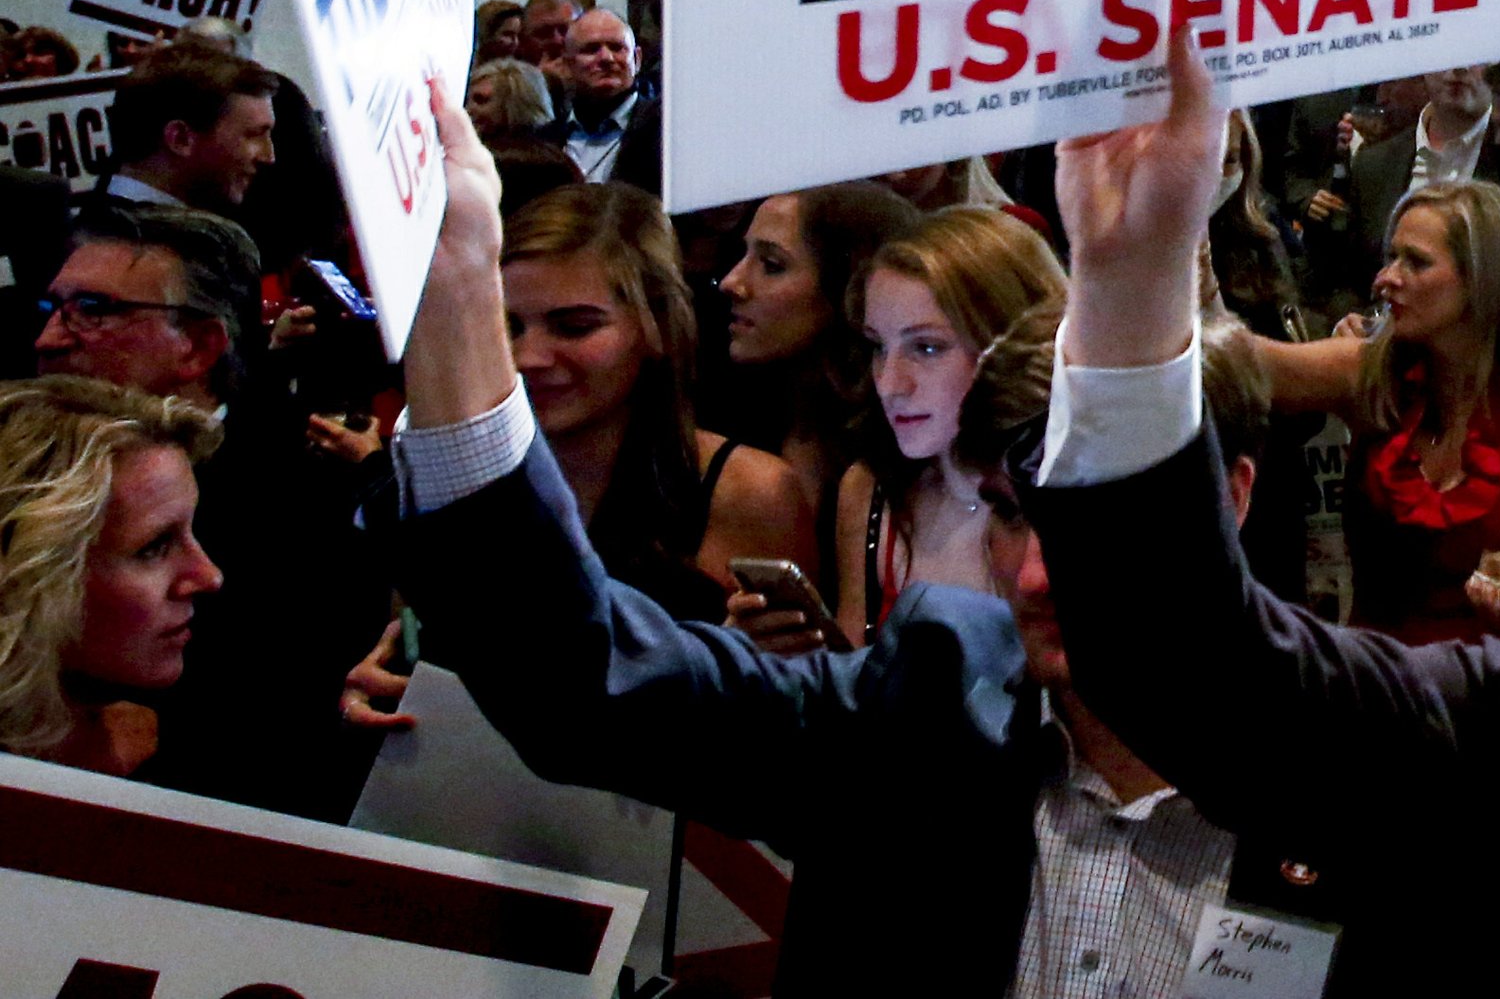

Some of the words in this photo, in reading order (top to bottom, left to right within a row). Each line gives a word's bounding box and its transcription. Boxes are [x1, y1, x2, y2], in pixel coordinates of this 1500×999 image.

[1010, 89, 1031, 106] BY
[1038, 72, 1131, 102] TUBERVILLE
[1135, 66, 1167, 84] FOR
[1262, 48, 1290, 63] BOX
[1217, 918, 1291, 955] Stephen
